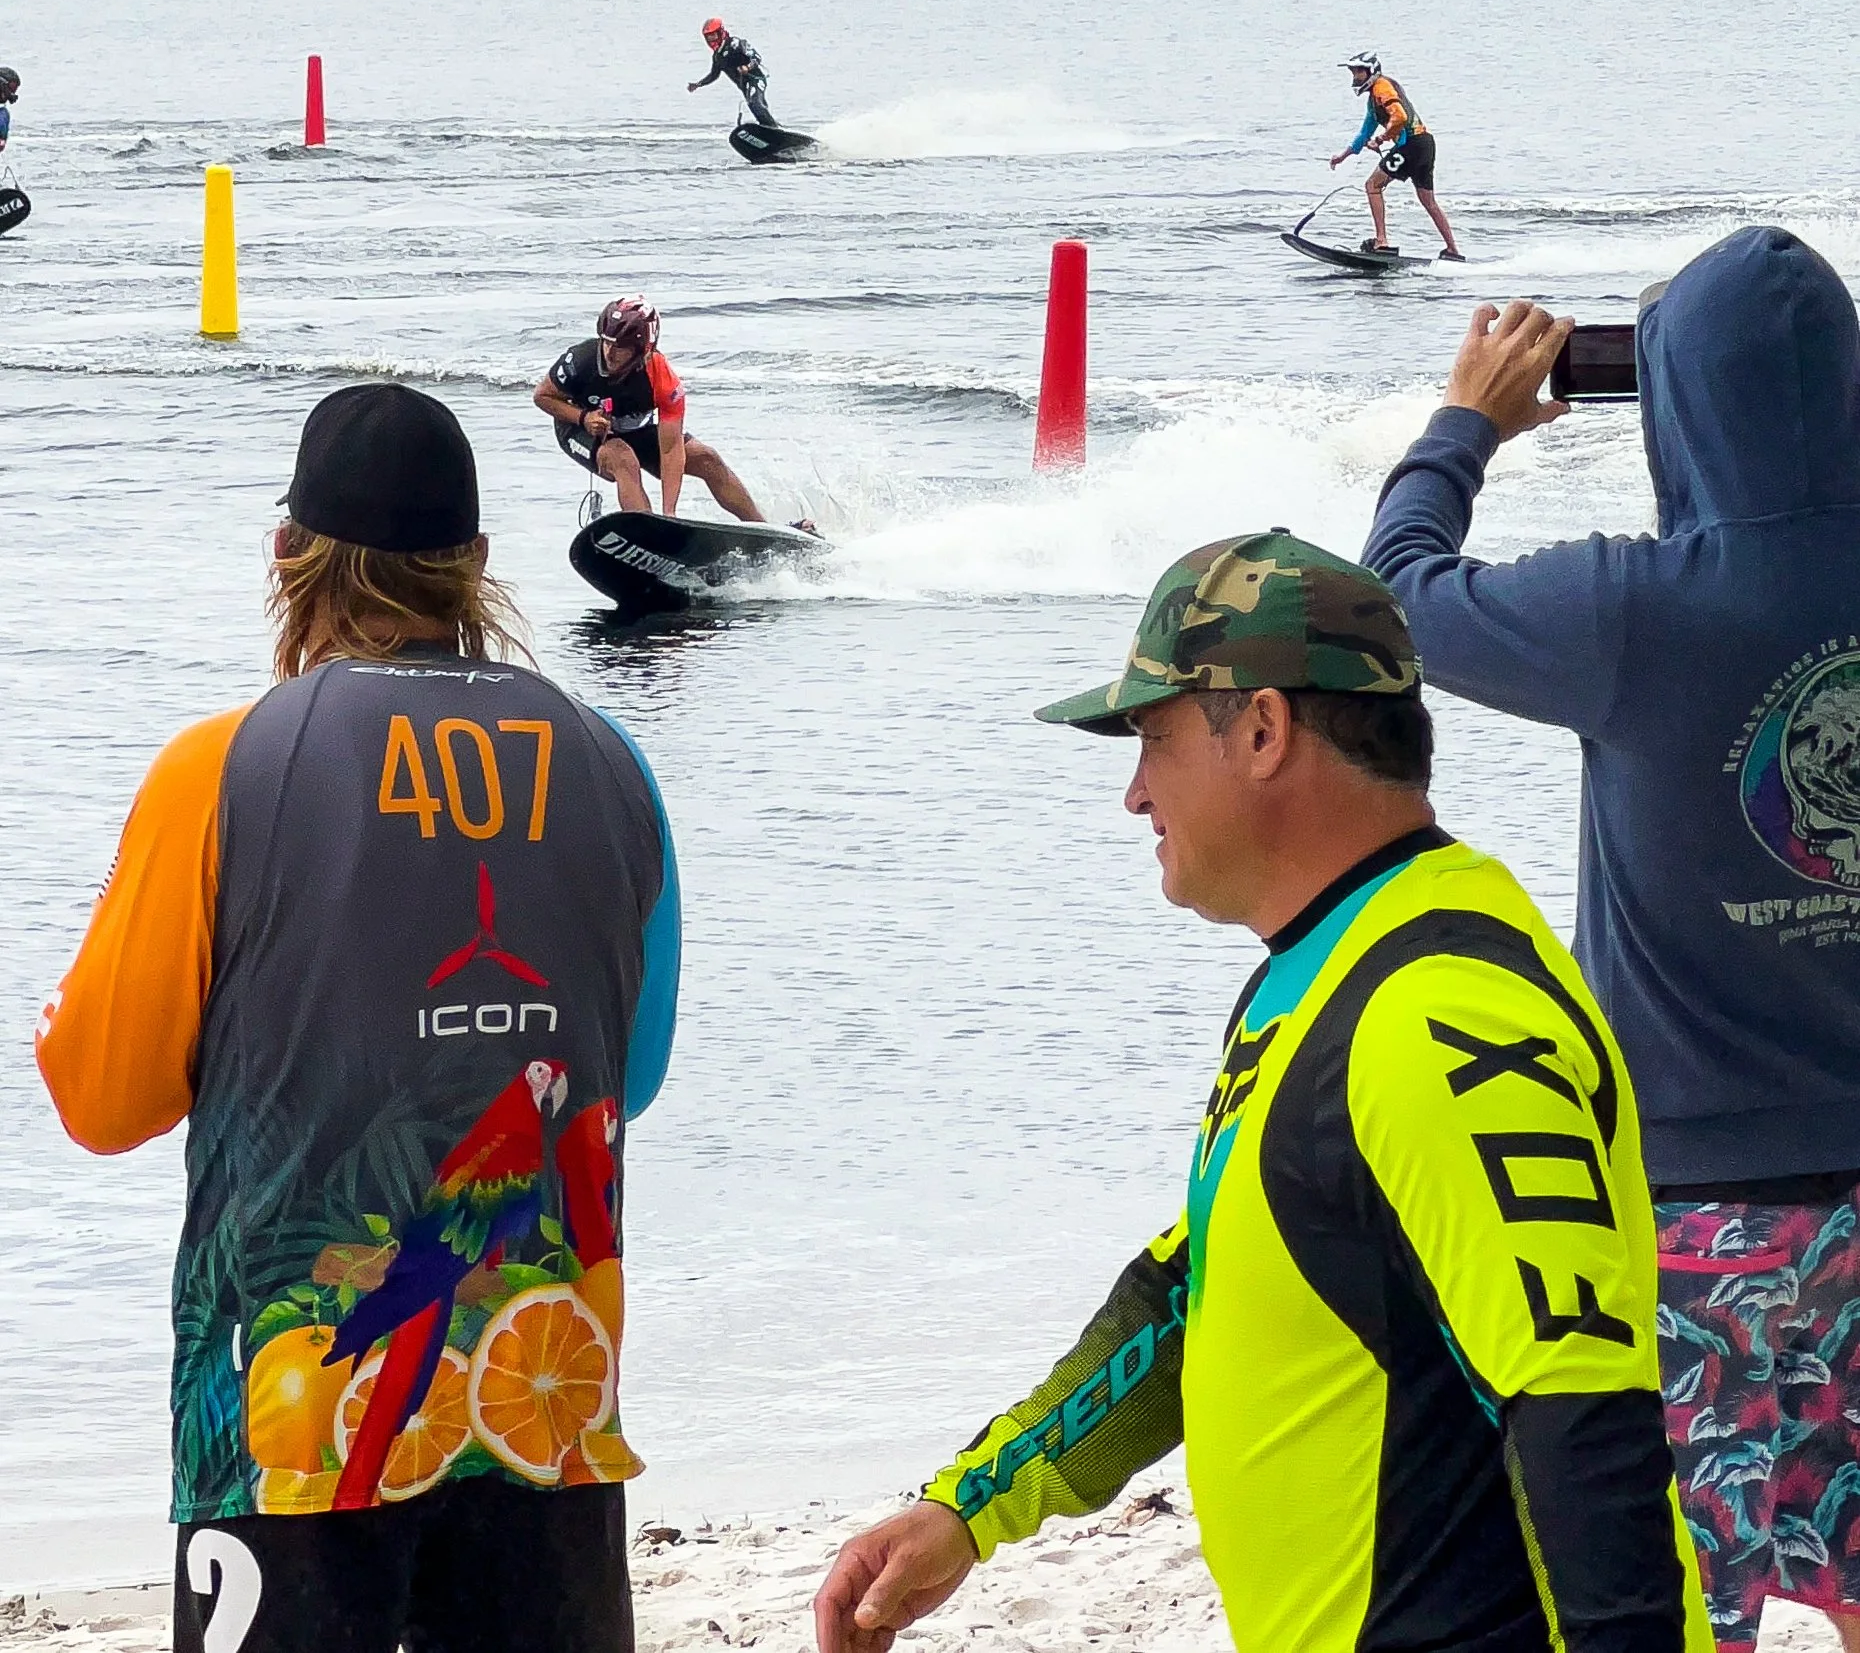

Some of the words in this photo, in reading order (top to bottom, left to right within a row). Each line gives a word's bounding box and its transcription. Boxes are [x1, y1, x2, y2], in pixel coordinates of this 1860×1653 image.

[1386, 153, 1405, 172] 3
[378, 715, 553, 842] 407
[1721, 899, 1792, 926] WEST
[1427, 1017, 1635, 1348] FOX
